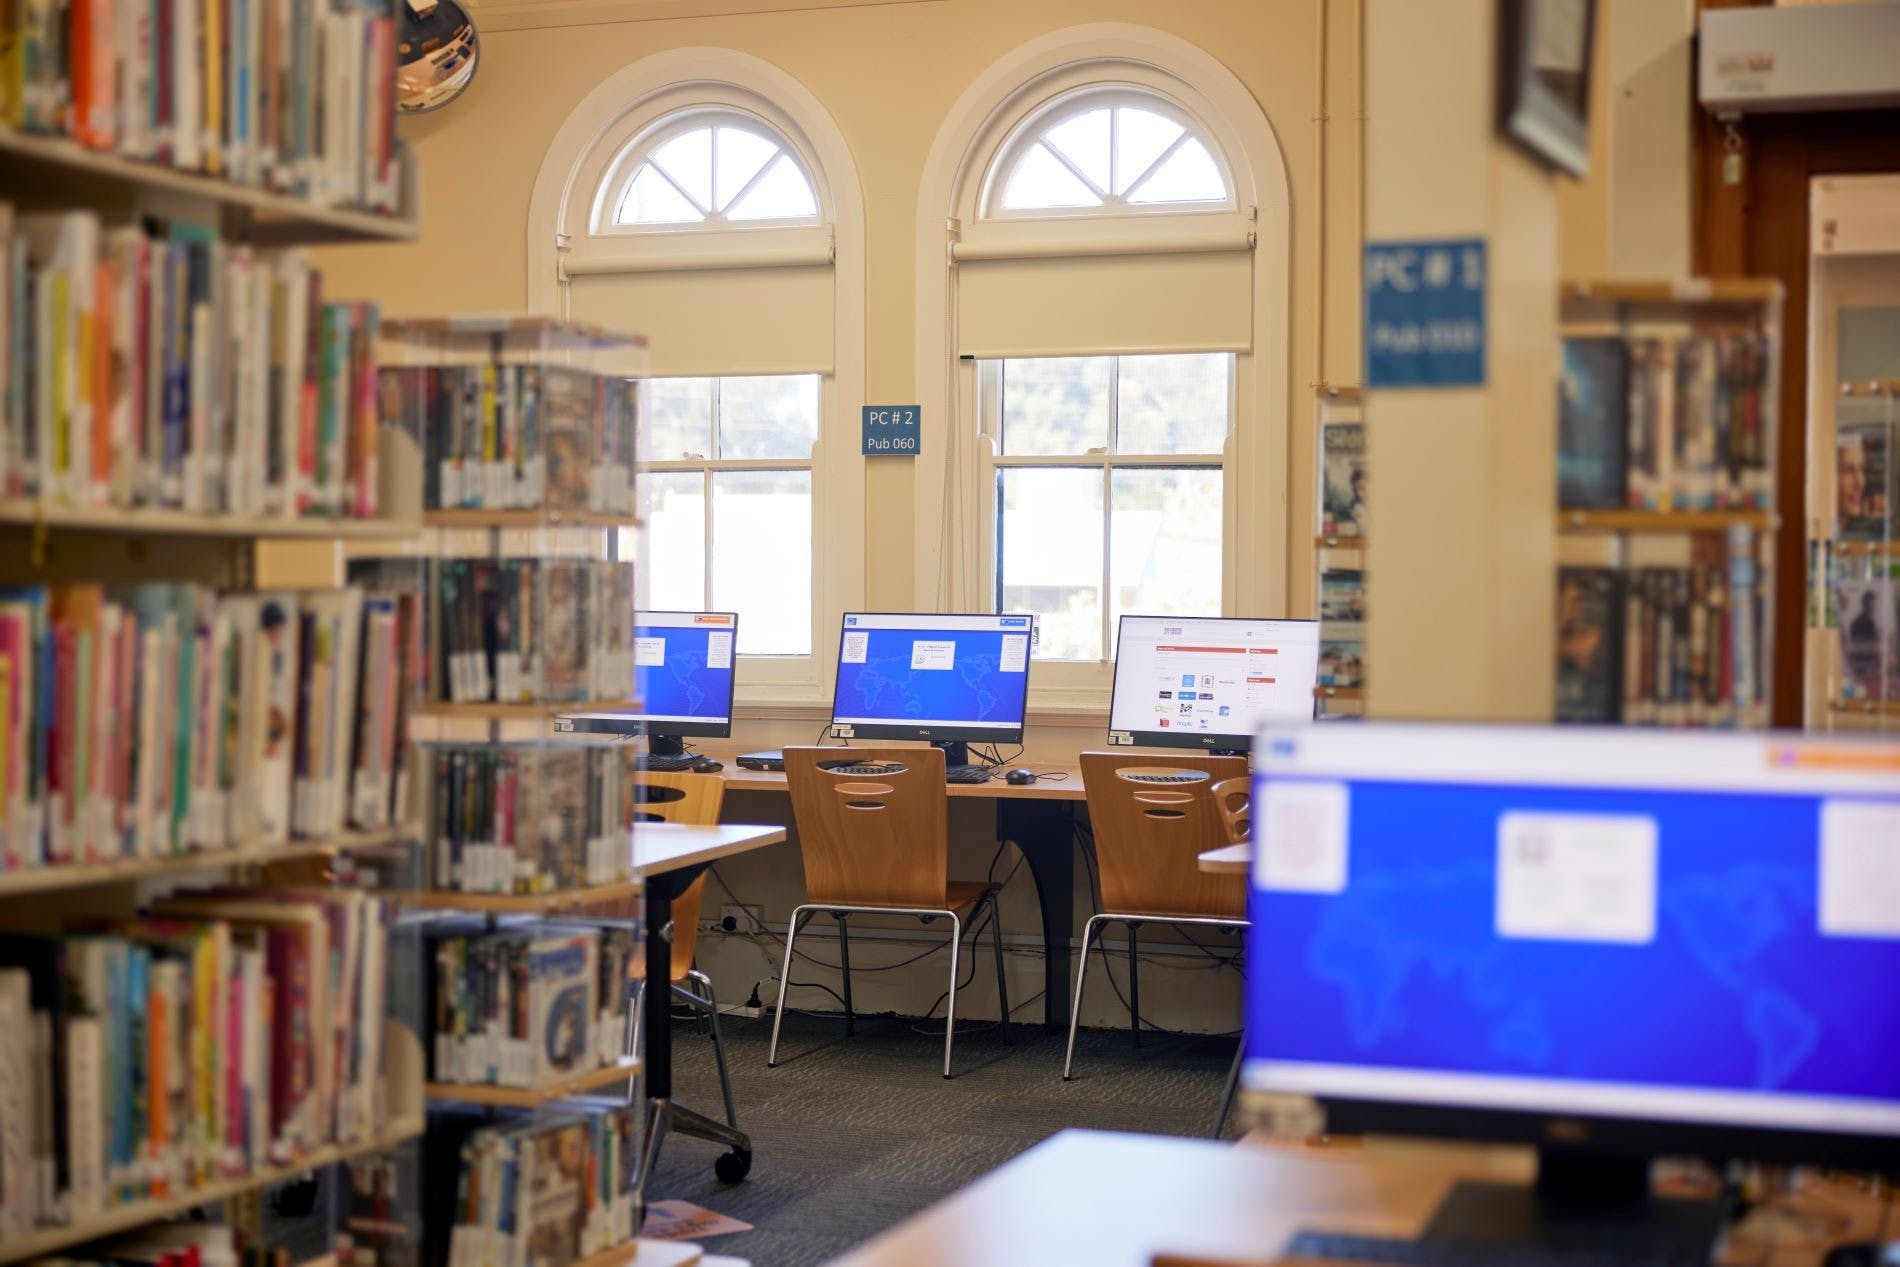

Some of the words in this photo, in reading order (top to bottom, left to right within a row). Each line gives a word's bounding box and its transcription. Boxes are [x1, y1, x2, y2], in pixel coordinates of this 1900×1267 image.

[870, 411, 888, 425] PC
[892, 411, 900, 424] #
[905, 411, 913, 424] 2
[868, 438, 890, 449] Pub
[893, 438, 915, 449] 060
